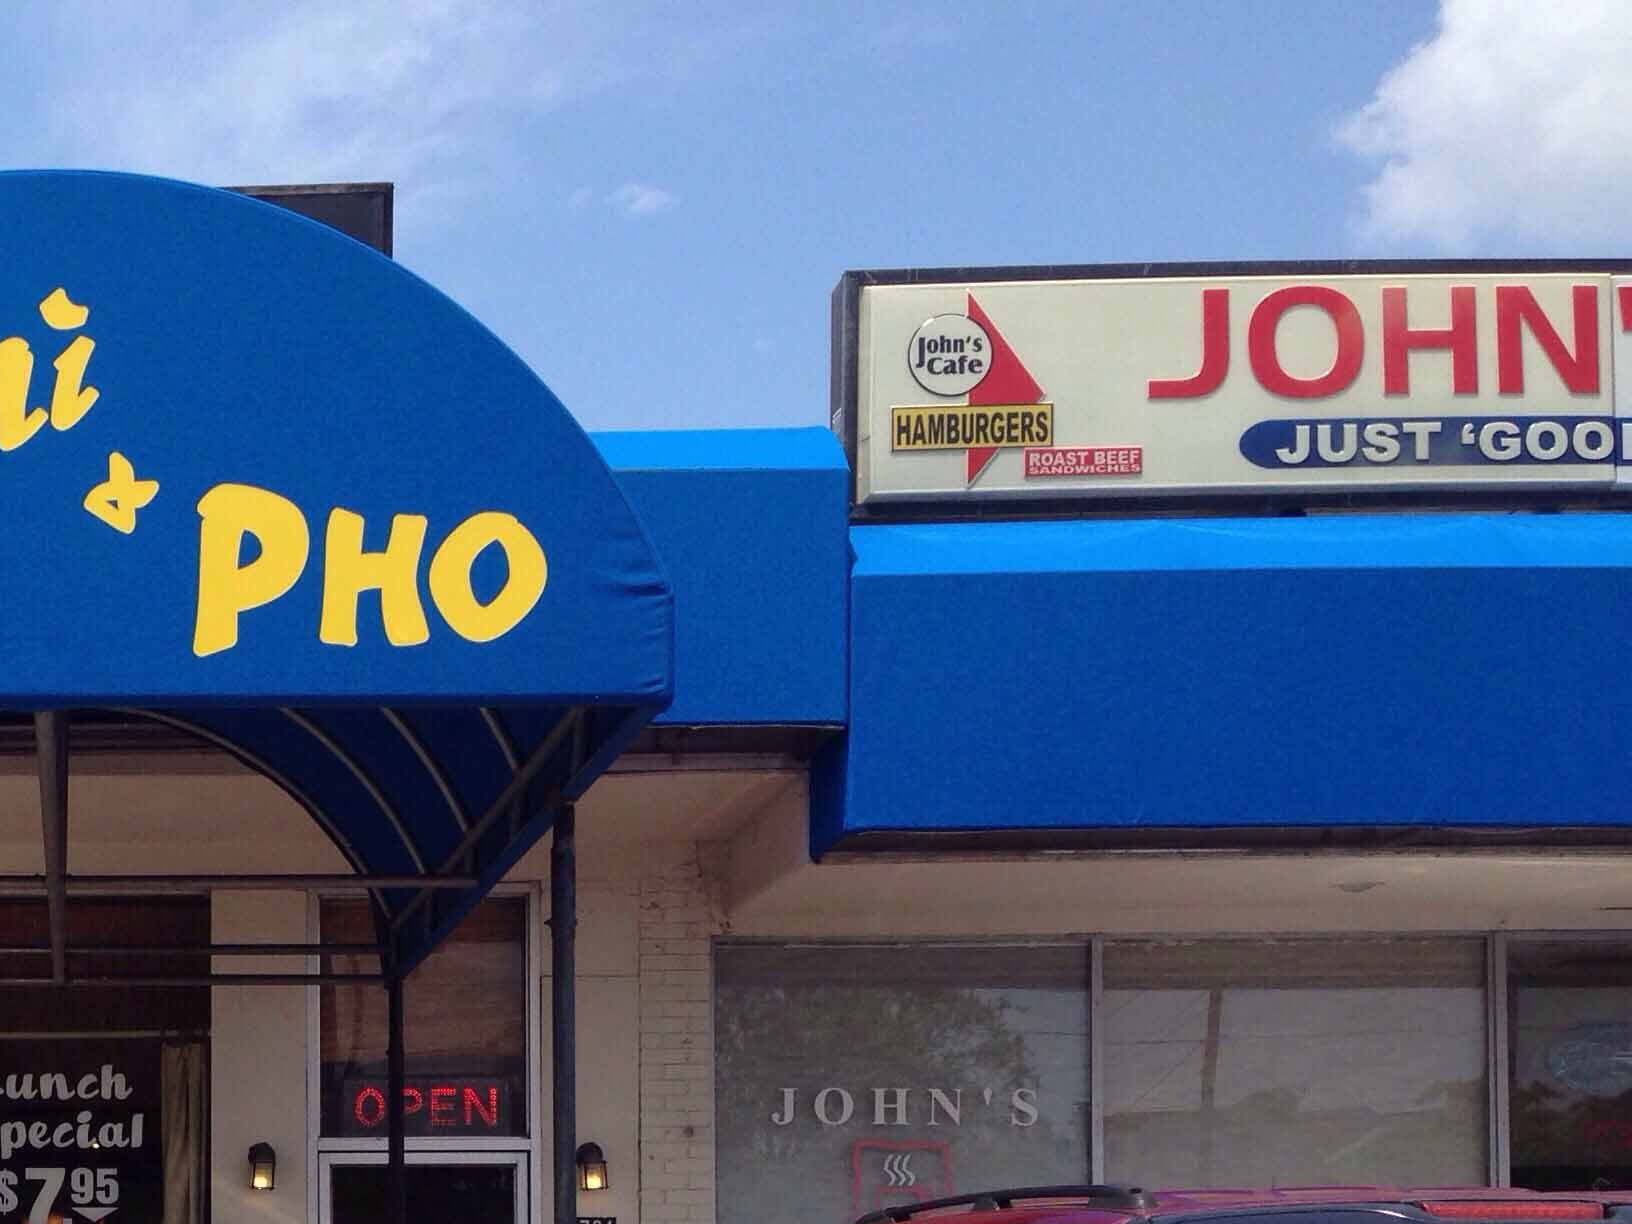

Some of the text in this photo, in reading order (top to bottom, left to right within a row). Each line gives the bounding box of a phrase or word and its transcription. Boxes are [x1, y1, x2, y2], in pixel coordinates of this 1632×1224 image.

[916, 334, 983, 368] John's
[926, 355, 983, 375] Cafe
[895, 410, 1050, 447] HAMBURGERS
[1274, 420, 1442, 465] JUST
[1029, 450, 1140, 466] ROAST BEEF
[1029, 464, 1141, 475] SANDWICHES
[82, 451, 159, 534] &
[192, 482, 548, 657] PHO
[353, 1086, 498, 1127] OPEN
[771, 1086, 1040, 1127] JOHN'S
